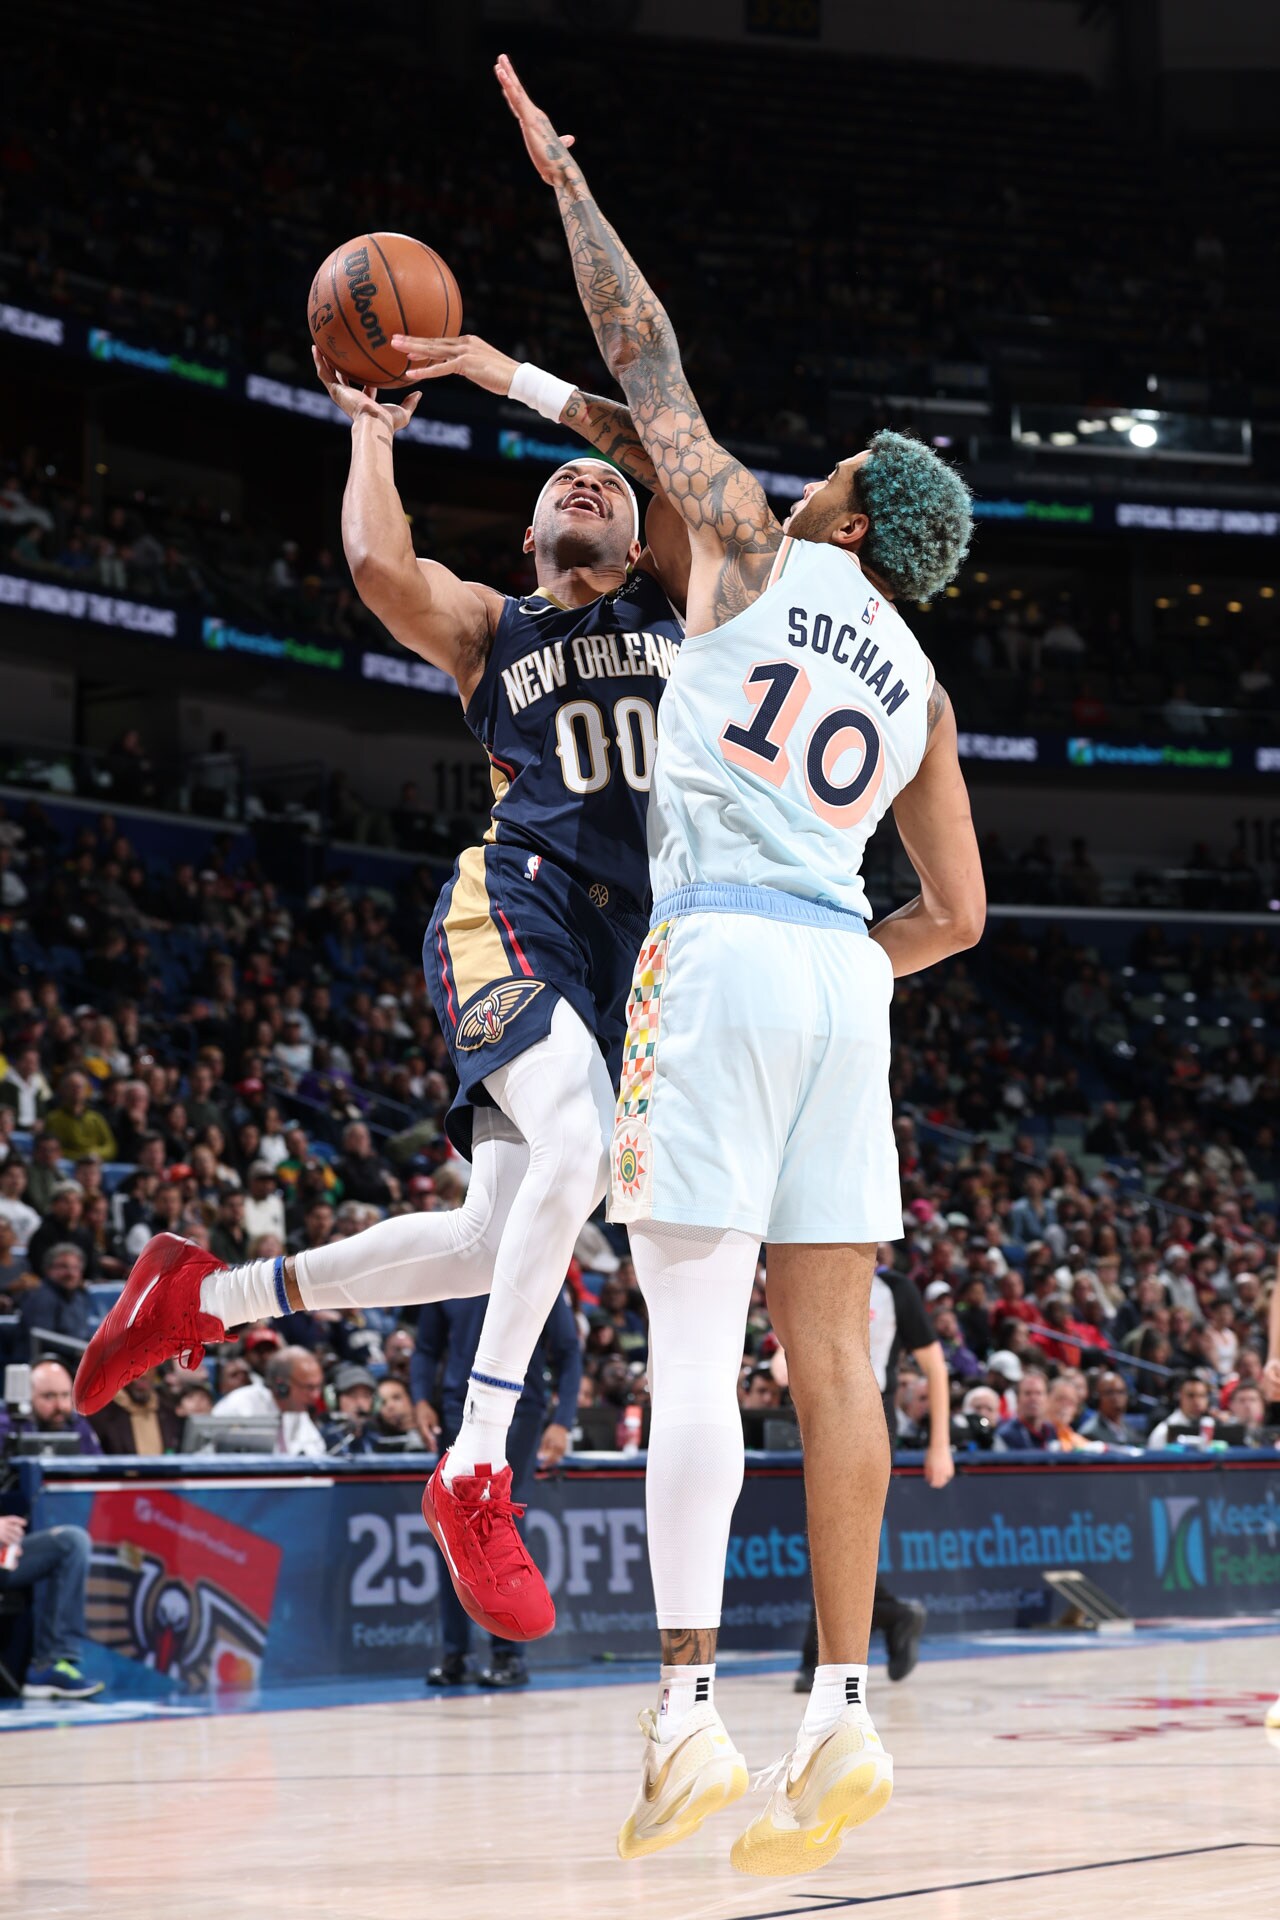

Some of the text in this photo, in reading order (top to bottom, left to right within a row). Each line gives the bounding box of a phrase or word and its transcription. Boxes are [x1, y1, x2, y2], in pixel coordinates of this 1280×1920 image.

[342, 246, 388, 350] Wilson
[501, 641, 567, 716] NEW
[788, 606, 910, 717] SOCHAN
[555, 696, 658, 794] 00
[719, 660, 883, 815] 10
[724, 1526, 808, 1580] kets
[901, 1512, 1132, 1572] merchandise
